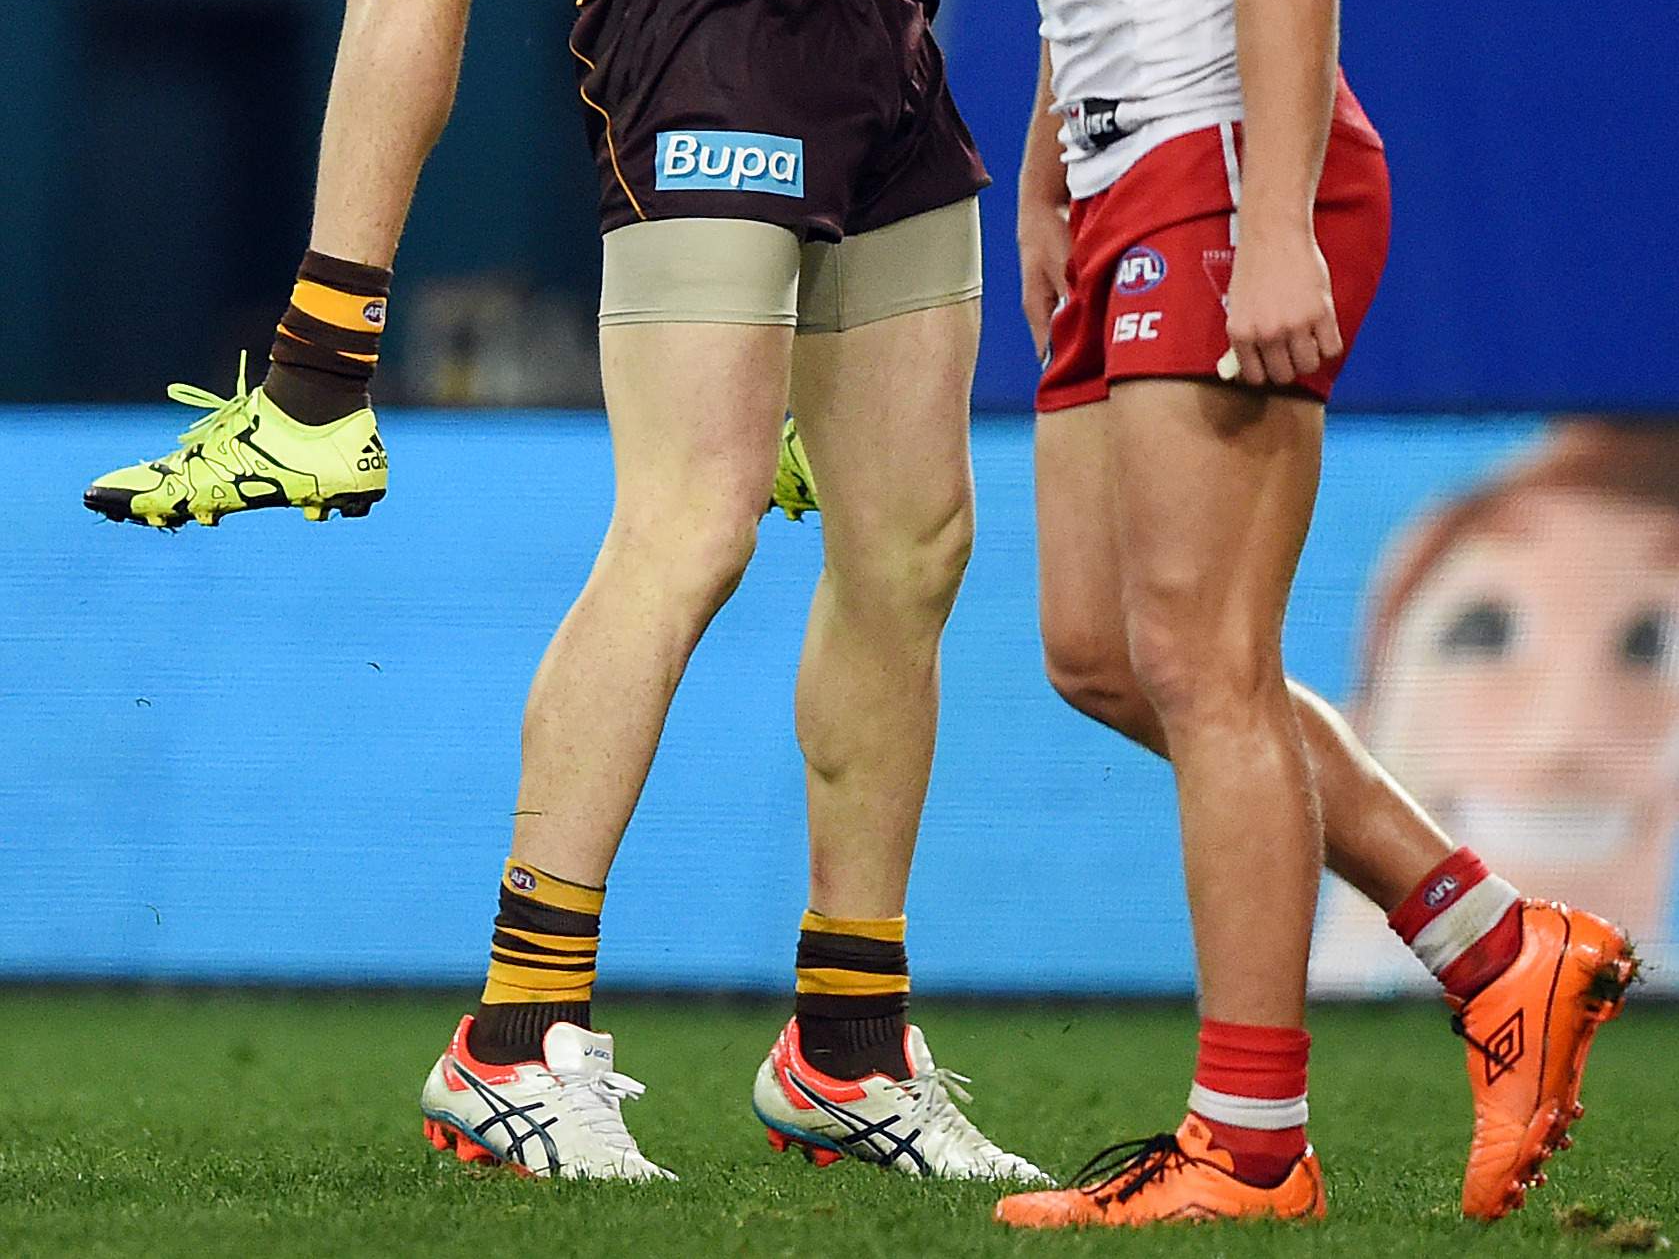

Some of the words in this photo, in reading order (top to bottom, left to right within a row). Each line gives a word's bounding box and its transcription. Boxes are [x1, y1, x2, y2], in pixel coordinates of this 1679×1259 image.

[663, 134, 797, 187] Bupa
[1116, 257, 1161, 286] AFL
[1112, 311, 1163, 344] ISC
[510, 868, 535, 890] AFL
[1428, 876, 1457, 906] AFL
